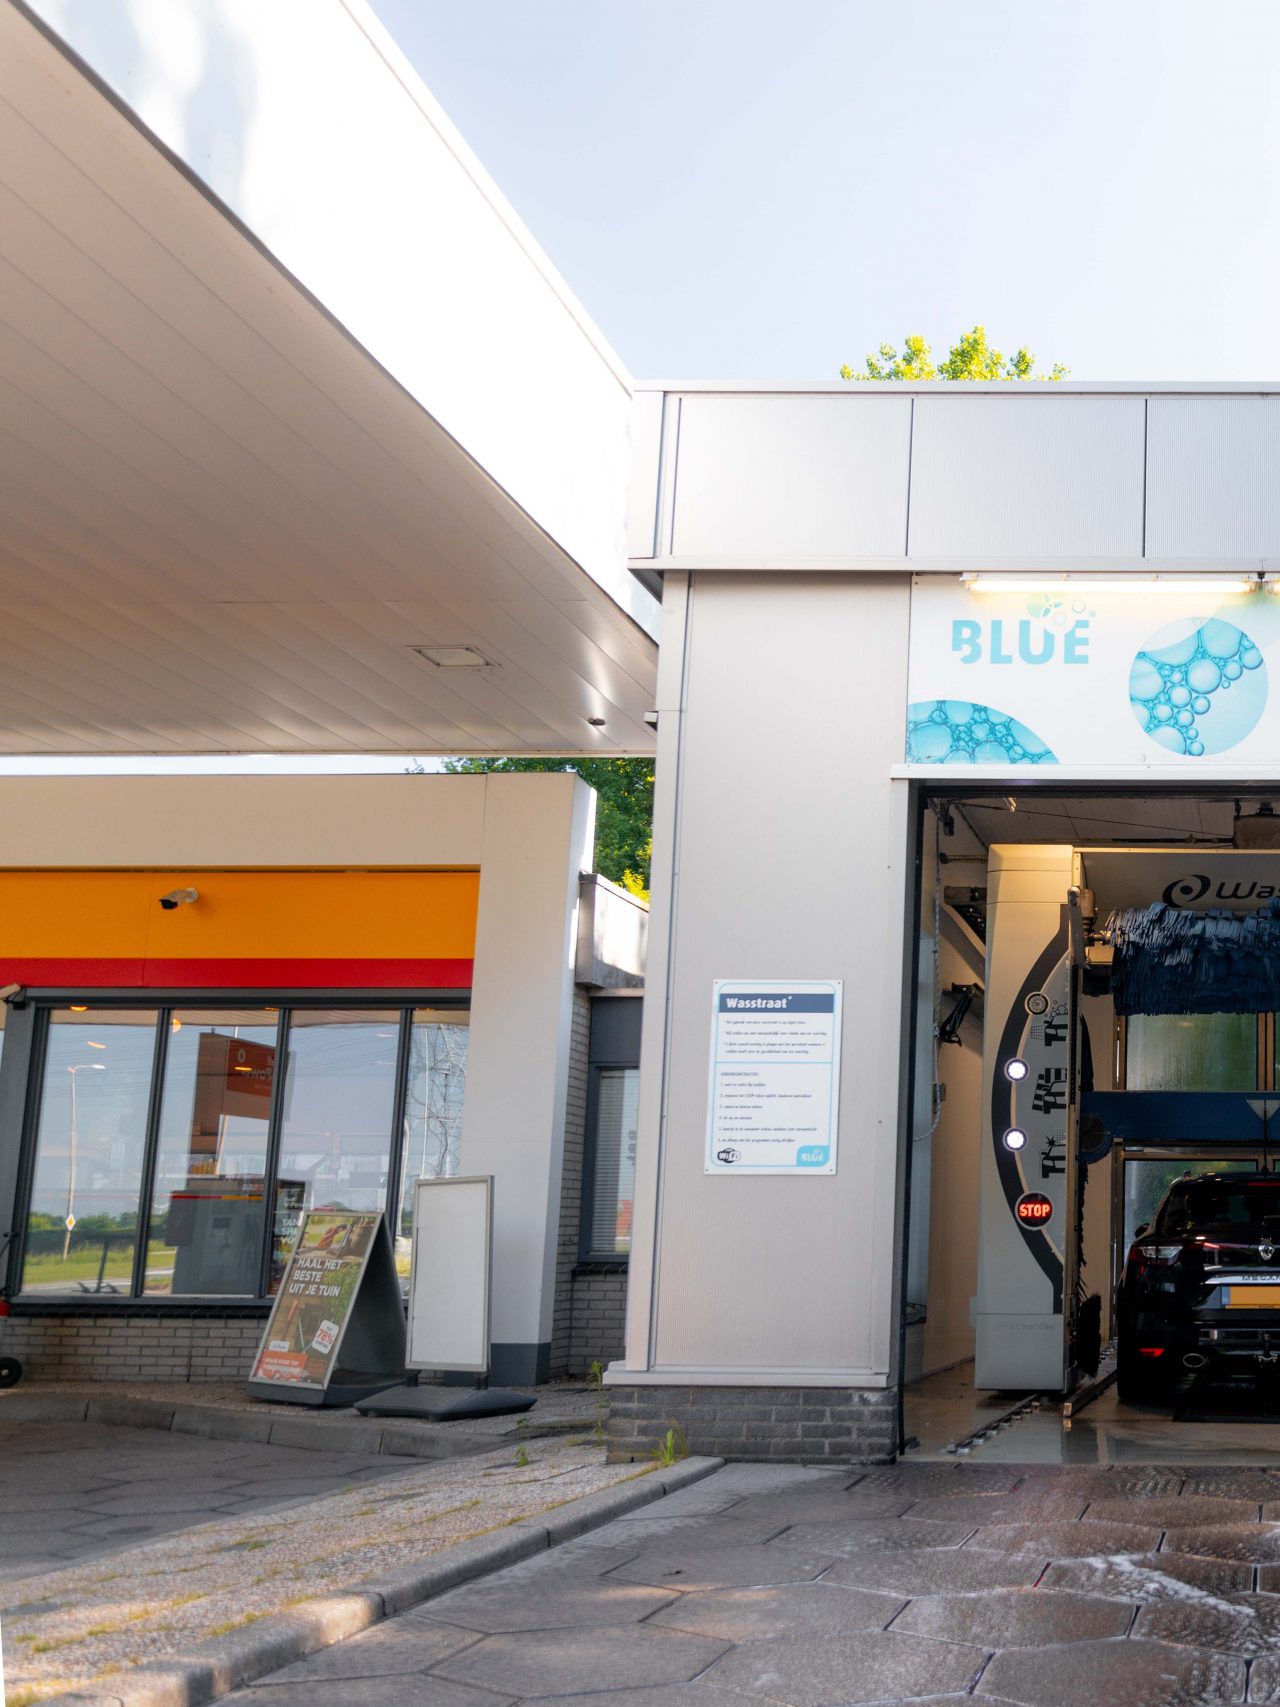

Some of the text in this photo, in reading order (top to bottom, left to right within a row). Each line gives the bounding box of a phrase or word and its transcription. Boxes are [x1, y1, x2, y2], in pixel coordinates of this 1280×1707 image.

[952, 619, 1089, 665] BLUE
[726, 997, 788, 1009] Wasstraat
[1020, 1203, 1051, 1217] STOP
[298, 1257, 344, 1270] HAAL HET
[293, 1270, 323, 1282] BESTE
[290, 1282, 341, 1297] UIT JE TUIN
